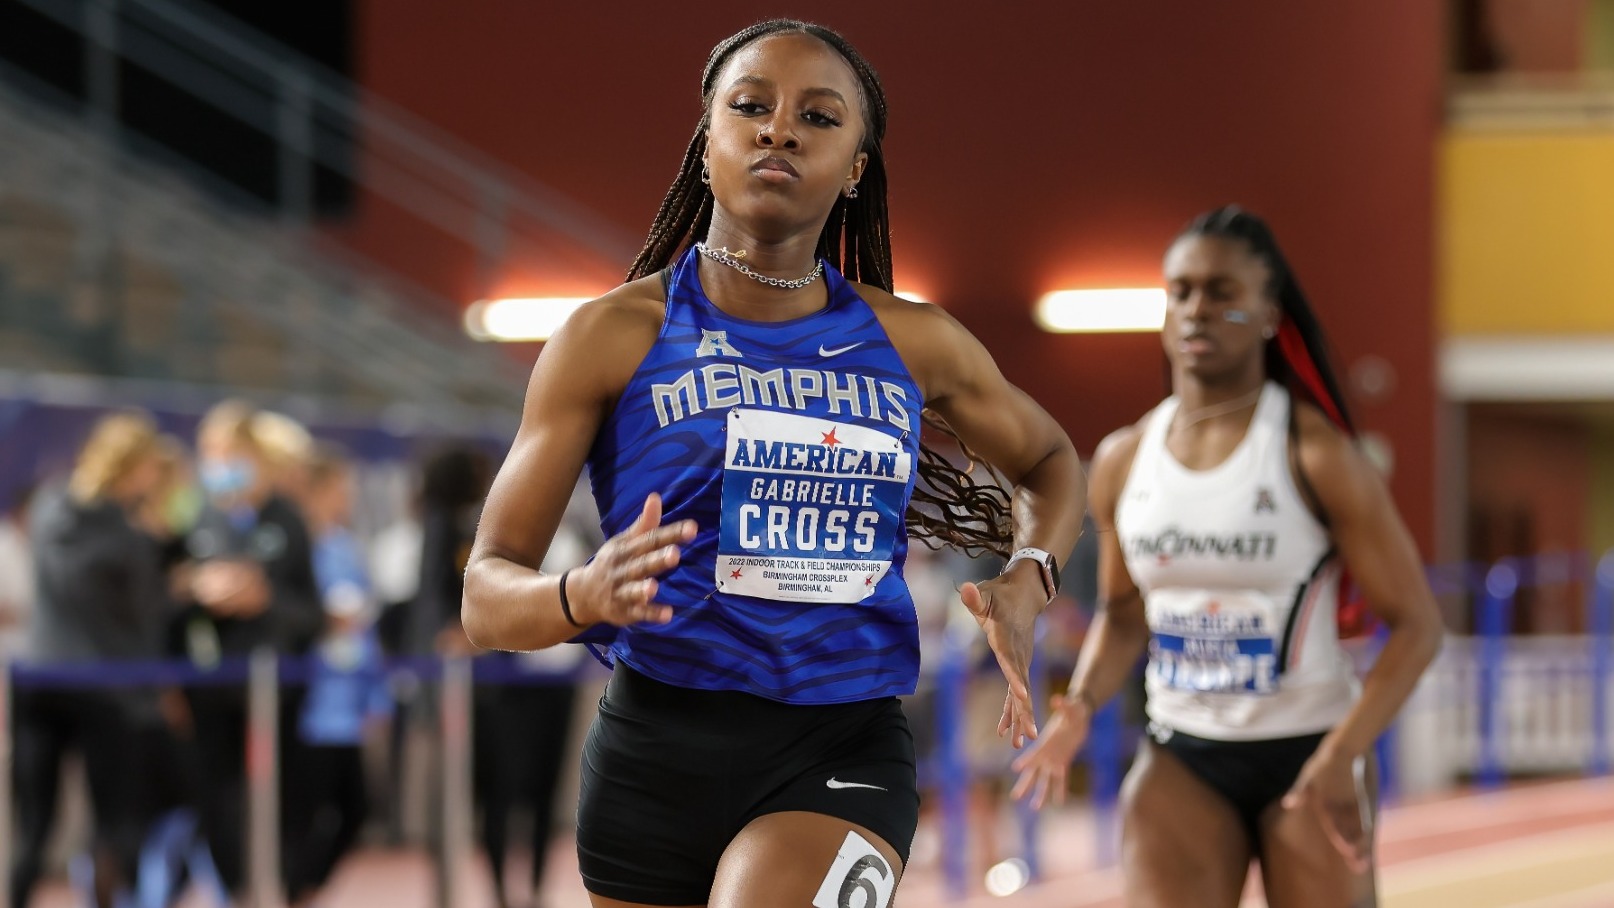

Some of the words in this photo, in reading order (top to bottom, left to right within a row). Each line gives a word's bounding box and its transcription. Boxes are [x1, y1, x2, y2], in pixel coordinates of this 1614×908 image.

[696, 329, 742, 358] A
[651, 363, 911, 432] MEMPHIS
[732, 438, 897, 478] AMERICAN
[750, 477, 875, 507] GABRIELLE
[739, 504, 880, 553] CROSS
[728, 557, 746, 567] 2022
[746, 558, 775, 569] INDOOR
[776, 560, 799, 570] TRACK
[800, 561, 806, 570] &
[807, 561, 825, 571] FIELD
[826, 562, 881, 572] CHAMPIONSHIPS
[762, 571, 808, 582] BIRMINGHAM
[808, 574, 849, 583] CROSSPLEX
[824, 584, 833, 593] AL
[837, 854, 889, 908] 6
